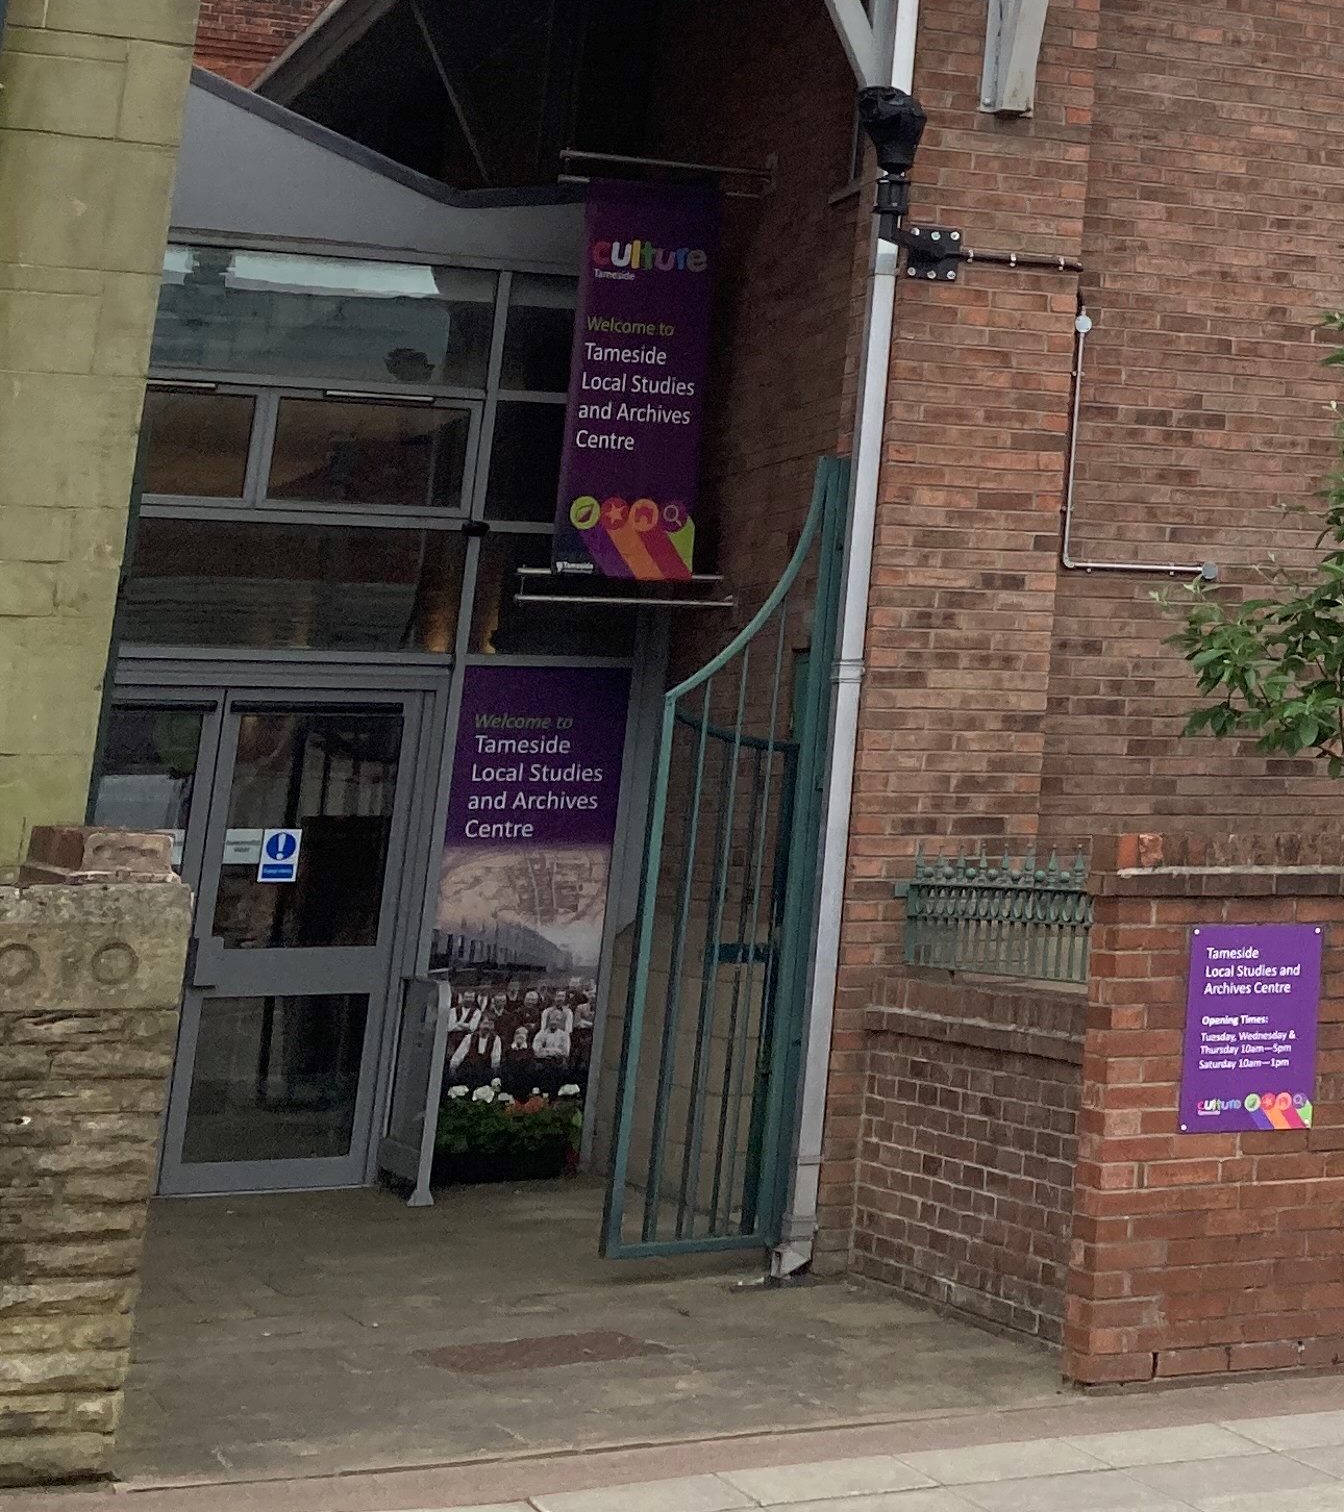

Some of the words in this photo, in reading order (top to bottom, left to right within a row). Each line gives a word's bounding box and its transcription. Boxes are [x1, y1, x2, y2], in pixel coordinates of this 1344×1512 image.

[592, 239, 708, 273] culture
[594, 268, 636, 280] Tameside
[587, 316, 656, 335] Welcome
[660, 322, 675, 336] to
[584, 342, 667, 365] Tameside
[581, 371, 627, 392] Local
[630, 375, 695, 396] Studies
[578, 400, 612, 420] and
[616, 403, 691, 424] Archives
[576, 430, 635, 450] Centre
[475, 713, 552, 729] Welcome
[556, 716, 573, 729] to
[475, 734, 571, 754] Tameside
[471, 762, 524, 782] Local
[528, 762, 604, 782] Studies
[467, 791, 507, 810] and
[512, 790, 599, 810] Archives
[465, 819, 534, 838] Centre
[1207, 946, 1260, 959] Tameside
[1205, 964, 1234, 978] Local
[1236, 963, 1277, 977] Studies
[1280, 963, 1301, 976] and
[1204, 982, 1252, 995] Archives
[1253, 981, 1292, 994] Centre
[1201, 1015, 1239, 1027] Opening
[1240, 1014, 1269, 1025] Times:
[1201, 1032, 1237, 1043] Tuesday,
[1239, 1030, 1287, 1041] Wednesday
[1288, 1029, 1296, 1039] &
[1200, 1045, 1239, 1055] Thursday
[1199, 1059, 1237, 1070] Saturday
